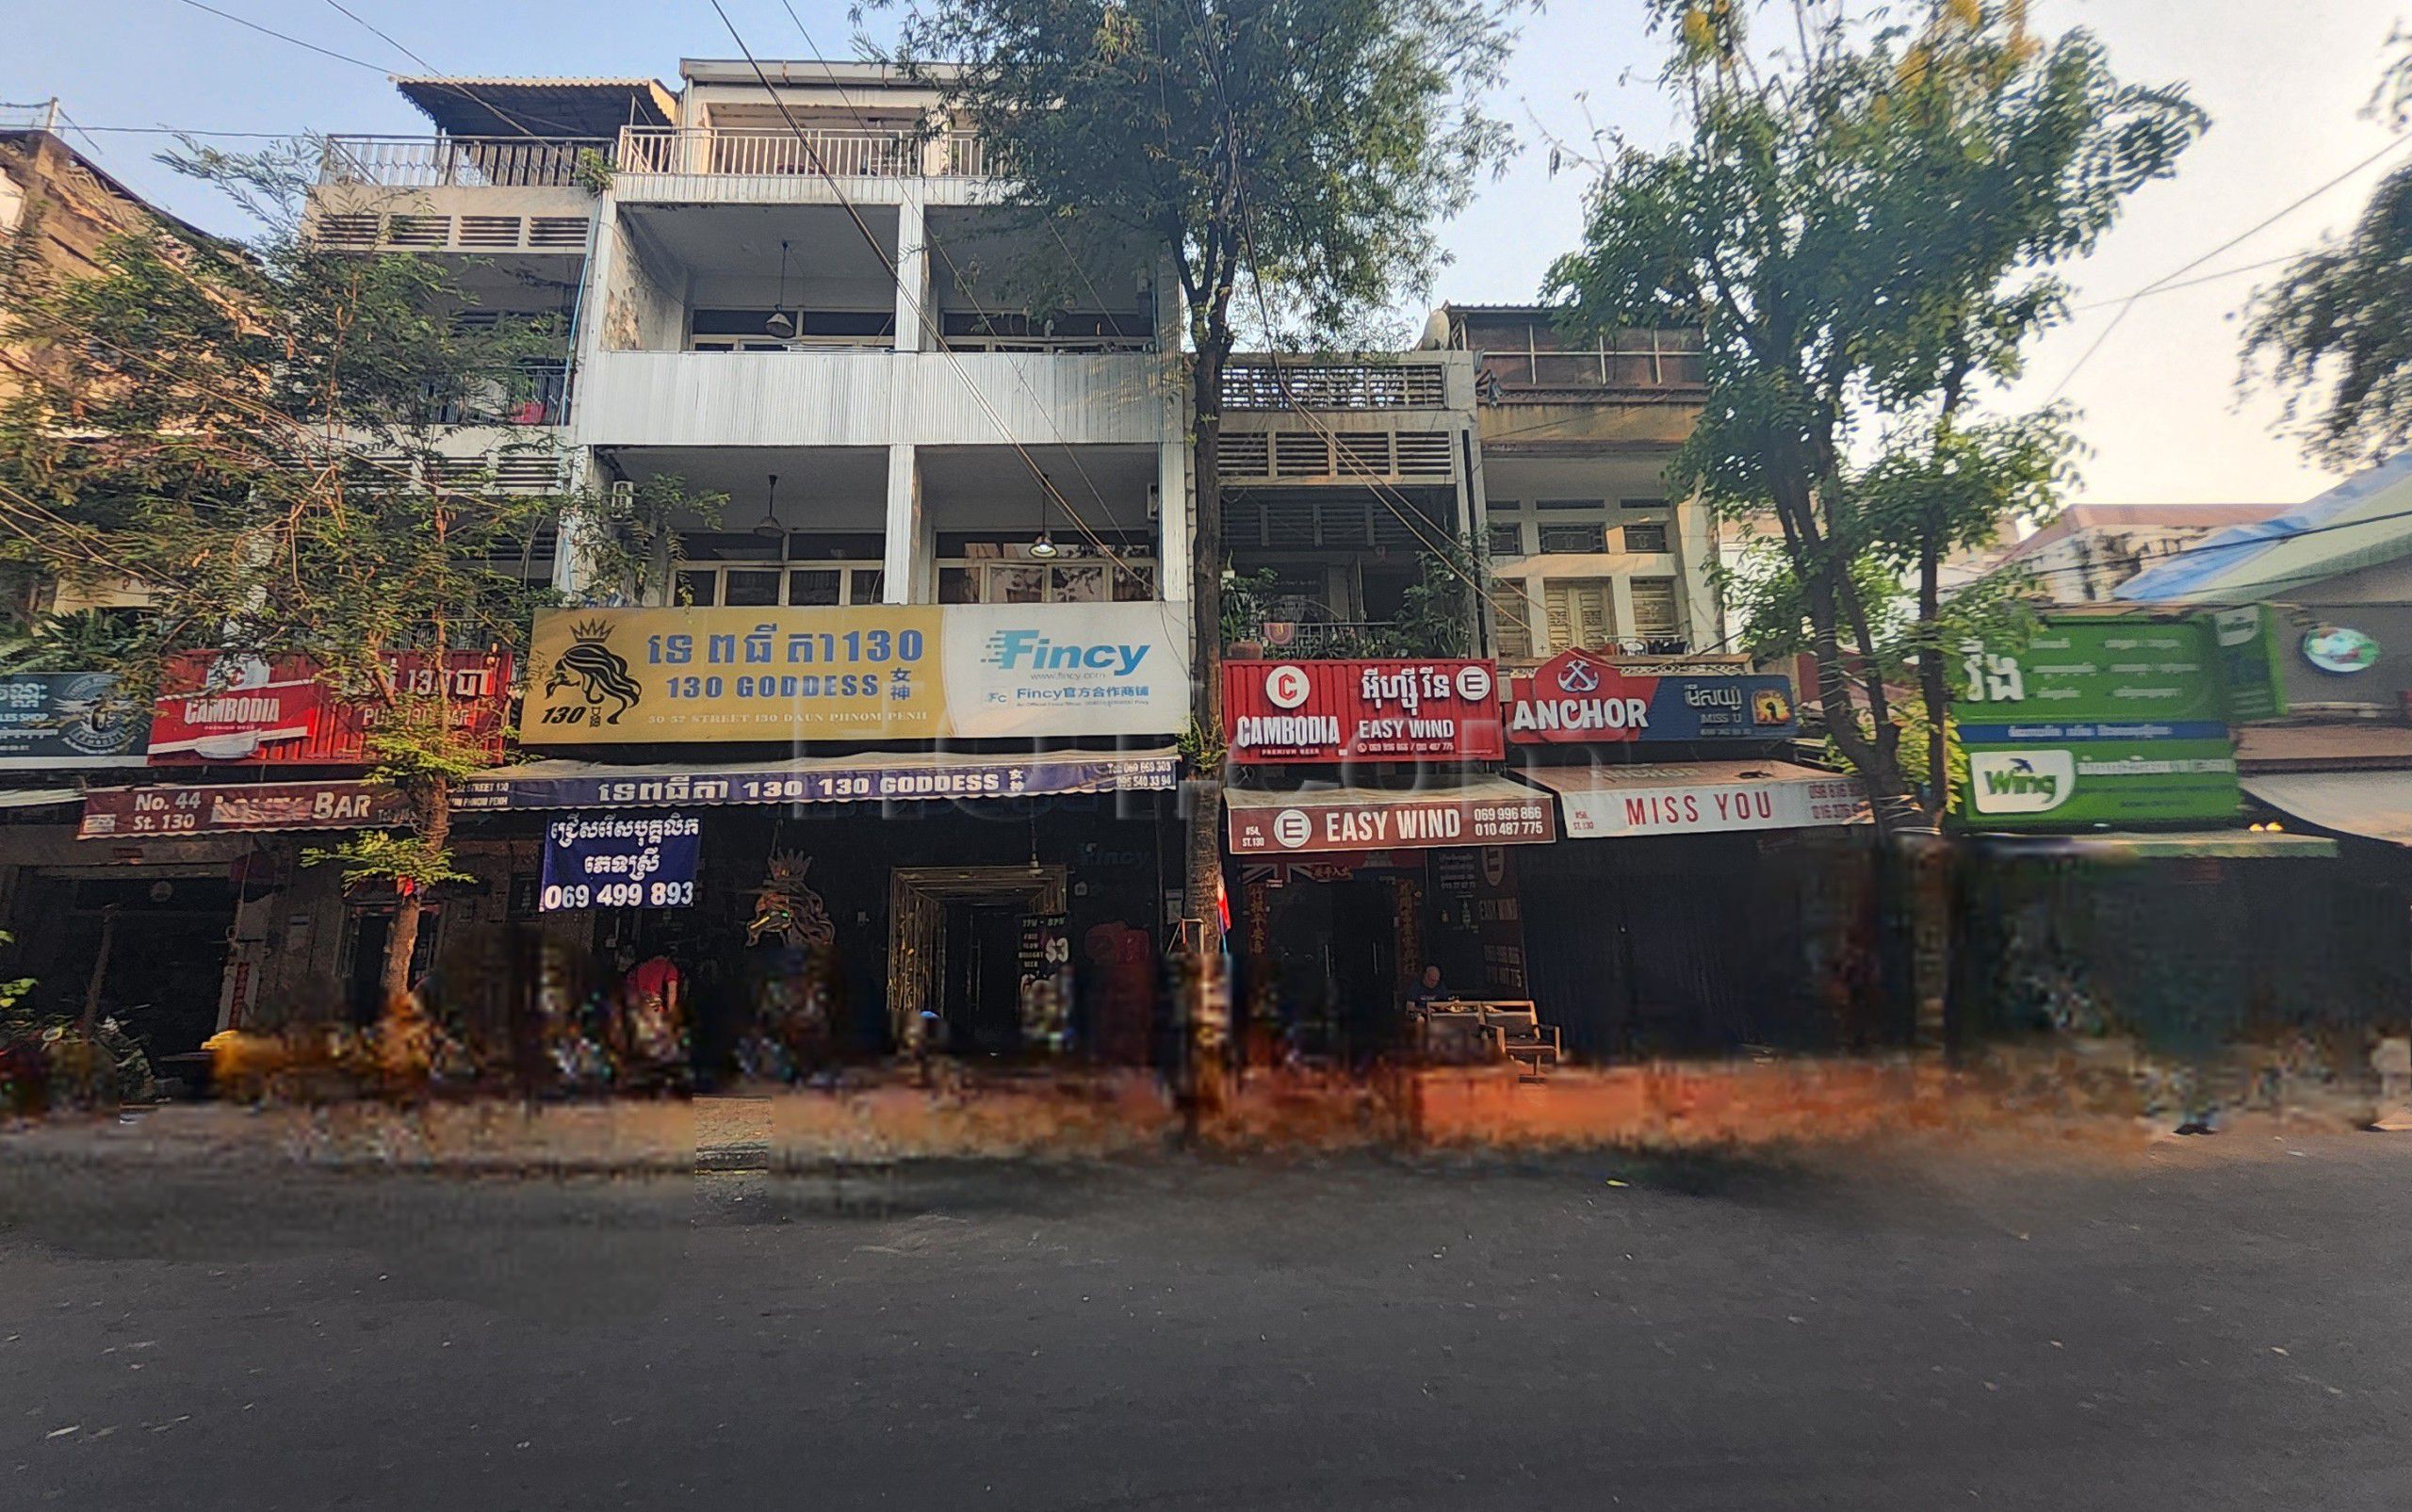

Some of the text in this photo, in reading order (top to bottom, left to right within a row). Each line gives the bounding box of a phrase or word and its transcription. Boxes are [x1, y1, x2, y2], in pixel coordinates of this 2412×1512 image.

[989, 629, 1151, 676] Fincy
[665, 674, 880, 699] 130 GODDESS
[889, 666, 912, 701] 女神
[184, 696, 281, 724] CAMBODIA
[540, 706, 587, 724] 130
[692, 714, 750, 723] STREET
[829, 711, 882, 723] PHNOM
[888, 710, 928, 722] PENH
[1511, 697, 1651, 731] ANCHOR
[1236, 715, 1341, 747] CAMBODIA
[1359, 719, 1455, 739] EASY WIND
[742, 780, 803, 799] 130
[818, 777, 870, 797] 130
[879, 772, 999, 794] GODDESS
[1983, 770, 2057, 805] Wing
[134, 793, 171, 812] No.
[174, 792, 202, 809] 44
[311, 790, 371, 821] BAR
[1474, 806, 1542, 821] 069 996 866
[1624, 790, 1772, 827] MISS YOU
[133, 815, 156, 831] St.
[162, 814, 196, 830] 130
[1326, 808, 1461, 843] EASY WIND
[1475, 821, 1543, 837] 010 487 775
[545, 881, 694, 910] 069 499 893
